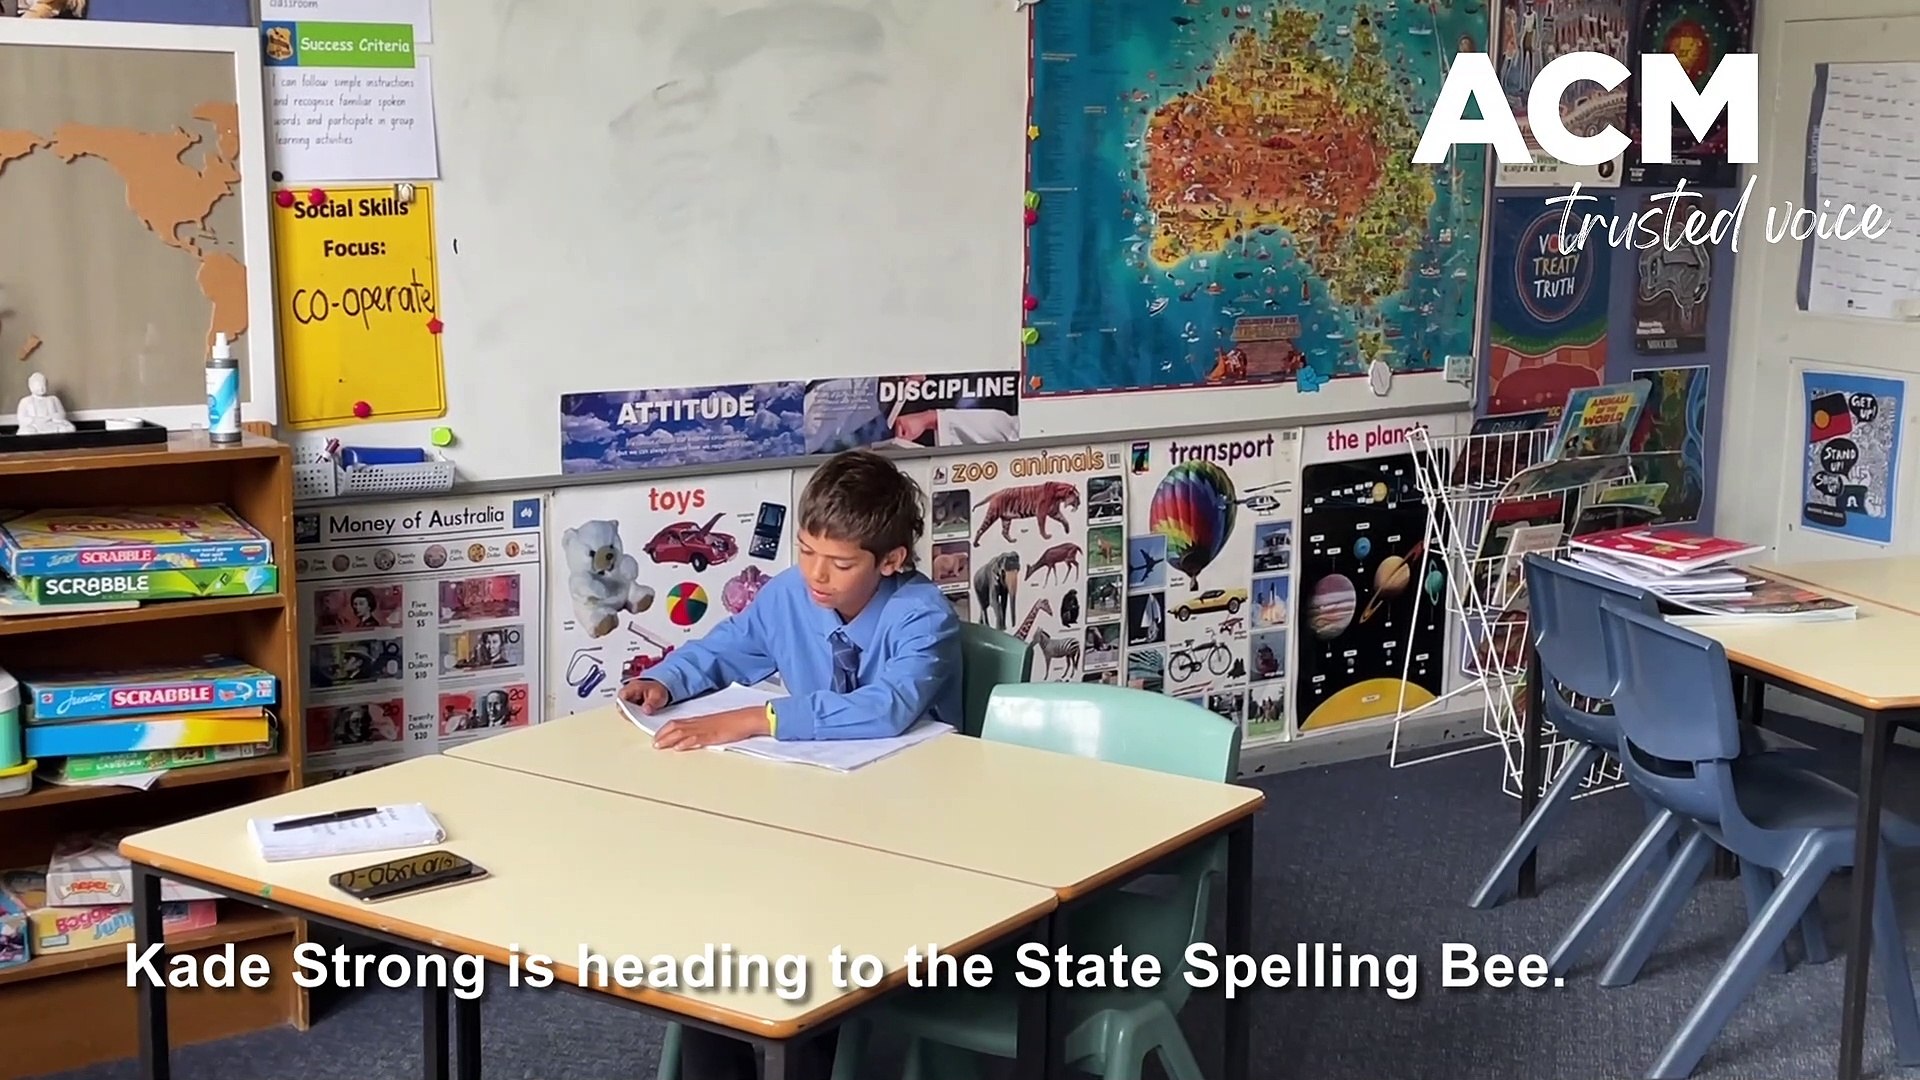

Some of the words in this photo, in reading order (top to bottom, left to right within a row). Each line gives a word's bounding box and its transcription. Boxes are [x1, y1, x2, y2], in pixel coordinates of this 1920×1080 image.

[300, 37, 353, 51] Success
[359, 39, 410, 52] Criteria
[272, 74, 276, 88] I
[281, 79, 297, 87] can
[302, 74, 328, 87] follow
[334, 75, 361, 92] simple
[366, 75, 414, 88] instructions
[273, 94, 288, 106] and
[294, 97, 334, 112] recognise
[339, 92, 372, 106] familiar
[378, 95, 406, 111] spoken
[273, 117, 300, 126] words
[306, 114, 322, 125] and
[328, 114, 373, 130] participate
[378, 116, 386, 125] in
[391, 117, 414, 131] group
[275, 133, 310, 150] learning
[315, 133, 353, 144] activities
[293, 198, 353, 219] Social
[359, 197, 408, 217] Skills
[323, 239, 386, 258] Focus:
[1533, 254, 1579, 276] TREATY
[1533, 277, 1575, 299] TRUTH
[292, 268, 435, 331] co-operate
[879, 376, 1015, 403] DISCIPLINE
[1591, 395, 1630, 407] ANIMALS
[1851, 395, 1872, 408] GET
[616, 394, 754, 426] ATTITUDE
[1859, 405, 1876, 419] UP!
[1583, 412, 1624, 426] WORLD
[1326, 429, 1359, 452] the
[1365, 421, 1429, 453] planets
[1169, 433, 1274, 466] transport
[1823, 447, 1857, 461] STAND
[952, 461, 998, 483] zoo
[1010, 447, 1104, 478] animals
[649, 487, 705, 514] toys
[329, 515, 395, 535] Money
[402, 511, 423, 528] of
[429, 506, 505, 528] Australia
[81, 549, 152, 565] SCRABBLE
[45, 575, 150, 597] SCRABBLE
[411, 600, 427, 608] Five
[408, 609, 433, 618] Dollars
[502, 629, 520, 644] 10
[382, 641, 400, 657] 10
[408, 660, 433, 669] Dollars
[415, 671, 428, 679] $10
[56, 690, 105, 715] Junior
[114, 687, 210, 706] SCRABBLE
[509, 688, 526, 701] 20
[408, 713, 434, 722] Twenty
[408, 722, 433, 731] Dollars
[414, 732, 428, 740] $20
